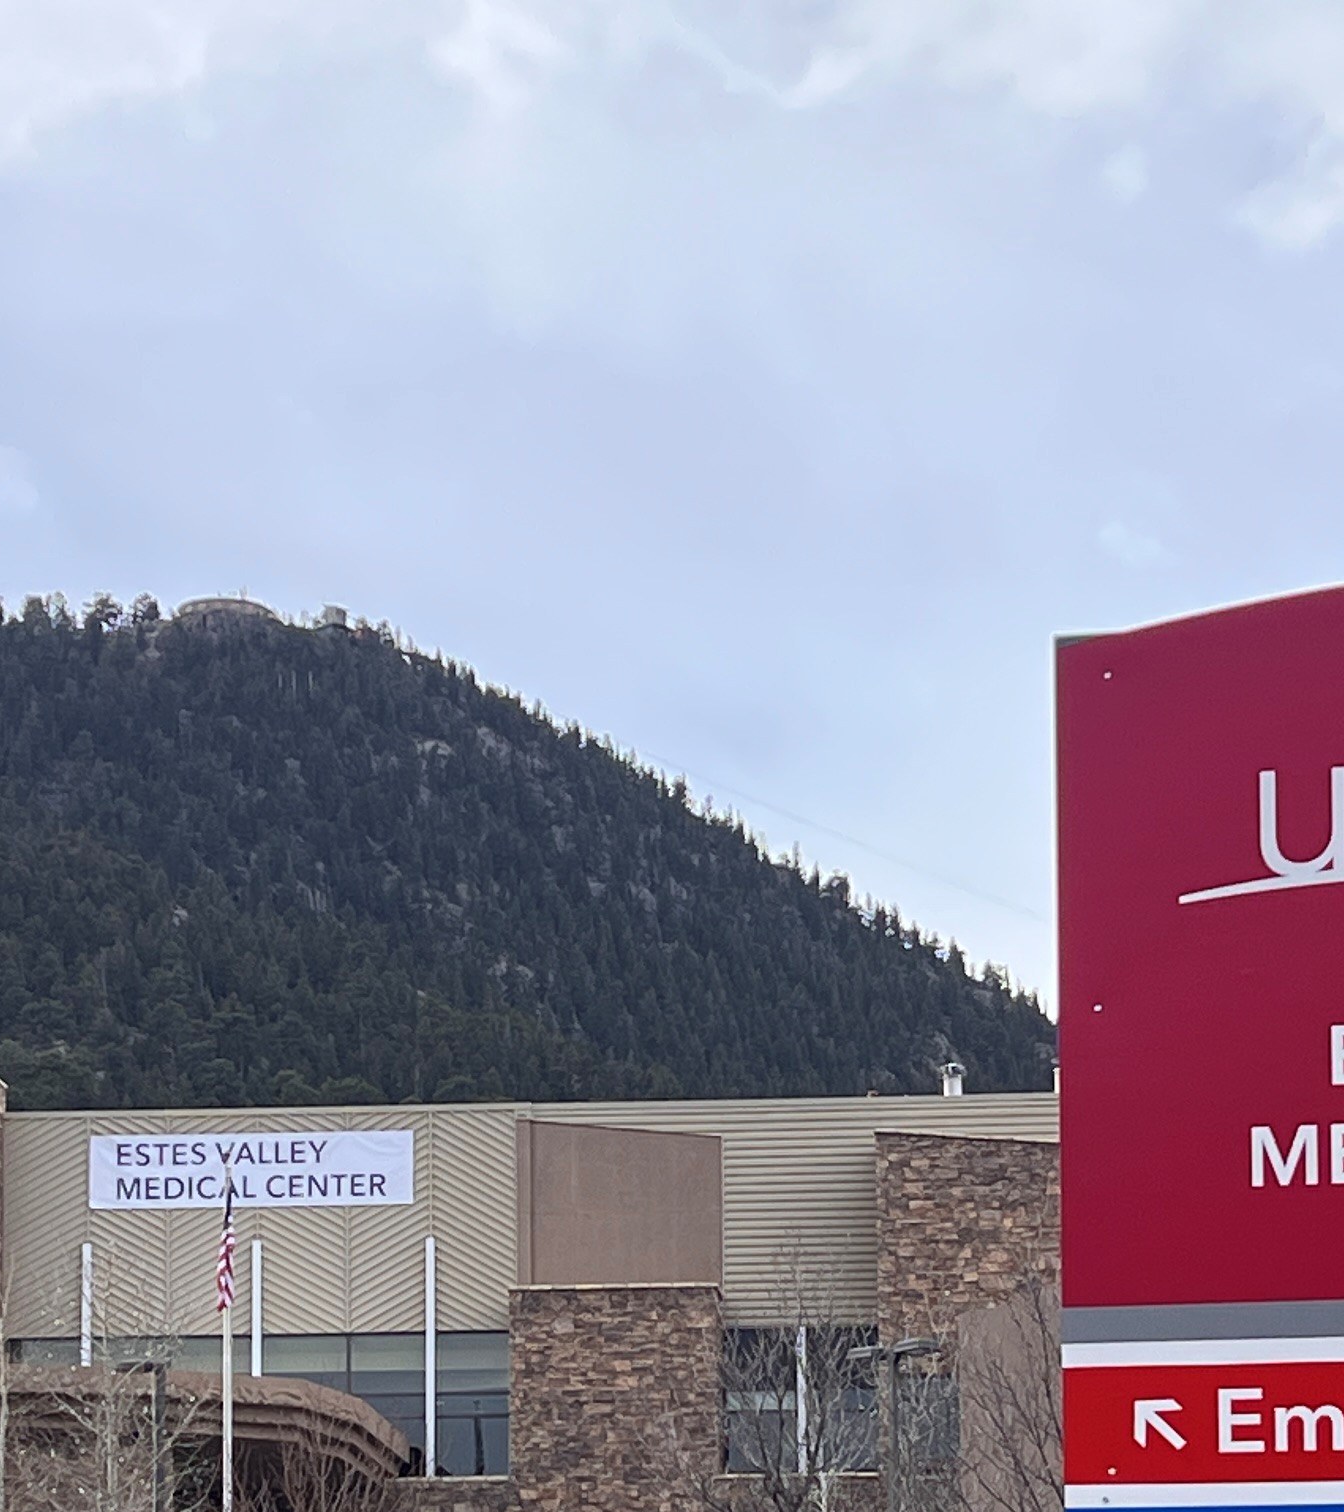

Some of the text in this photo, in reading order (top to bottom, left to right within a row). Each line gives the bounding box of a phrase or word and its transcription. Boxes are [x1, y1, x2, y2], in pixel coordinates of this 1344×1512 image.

[116, 1140, 327, 1167] ESTES VALLEY
[116, 1173, 387, 1200] MEDICAL CENTER
